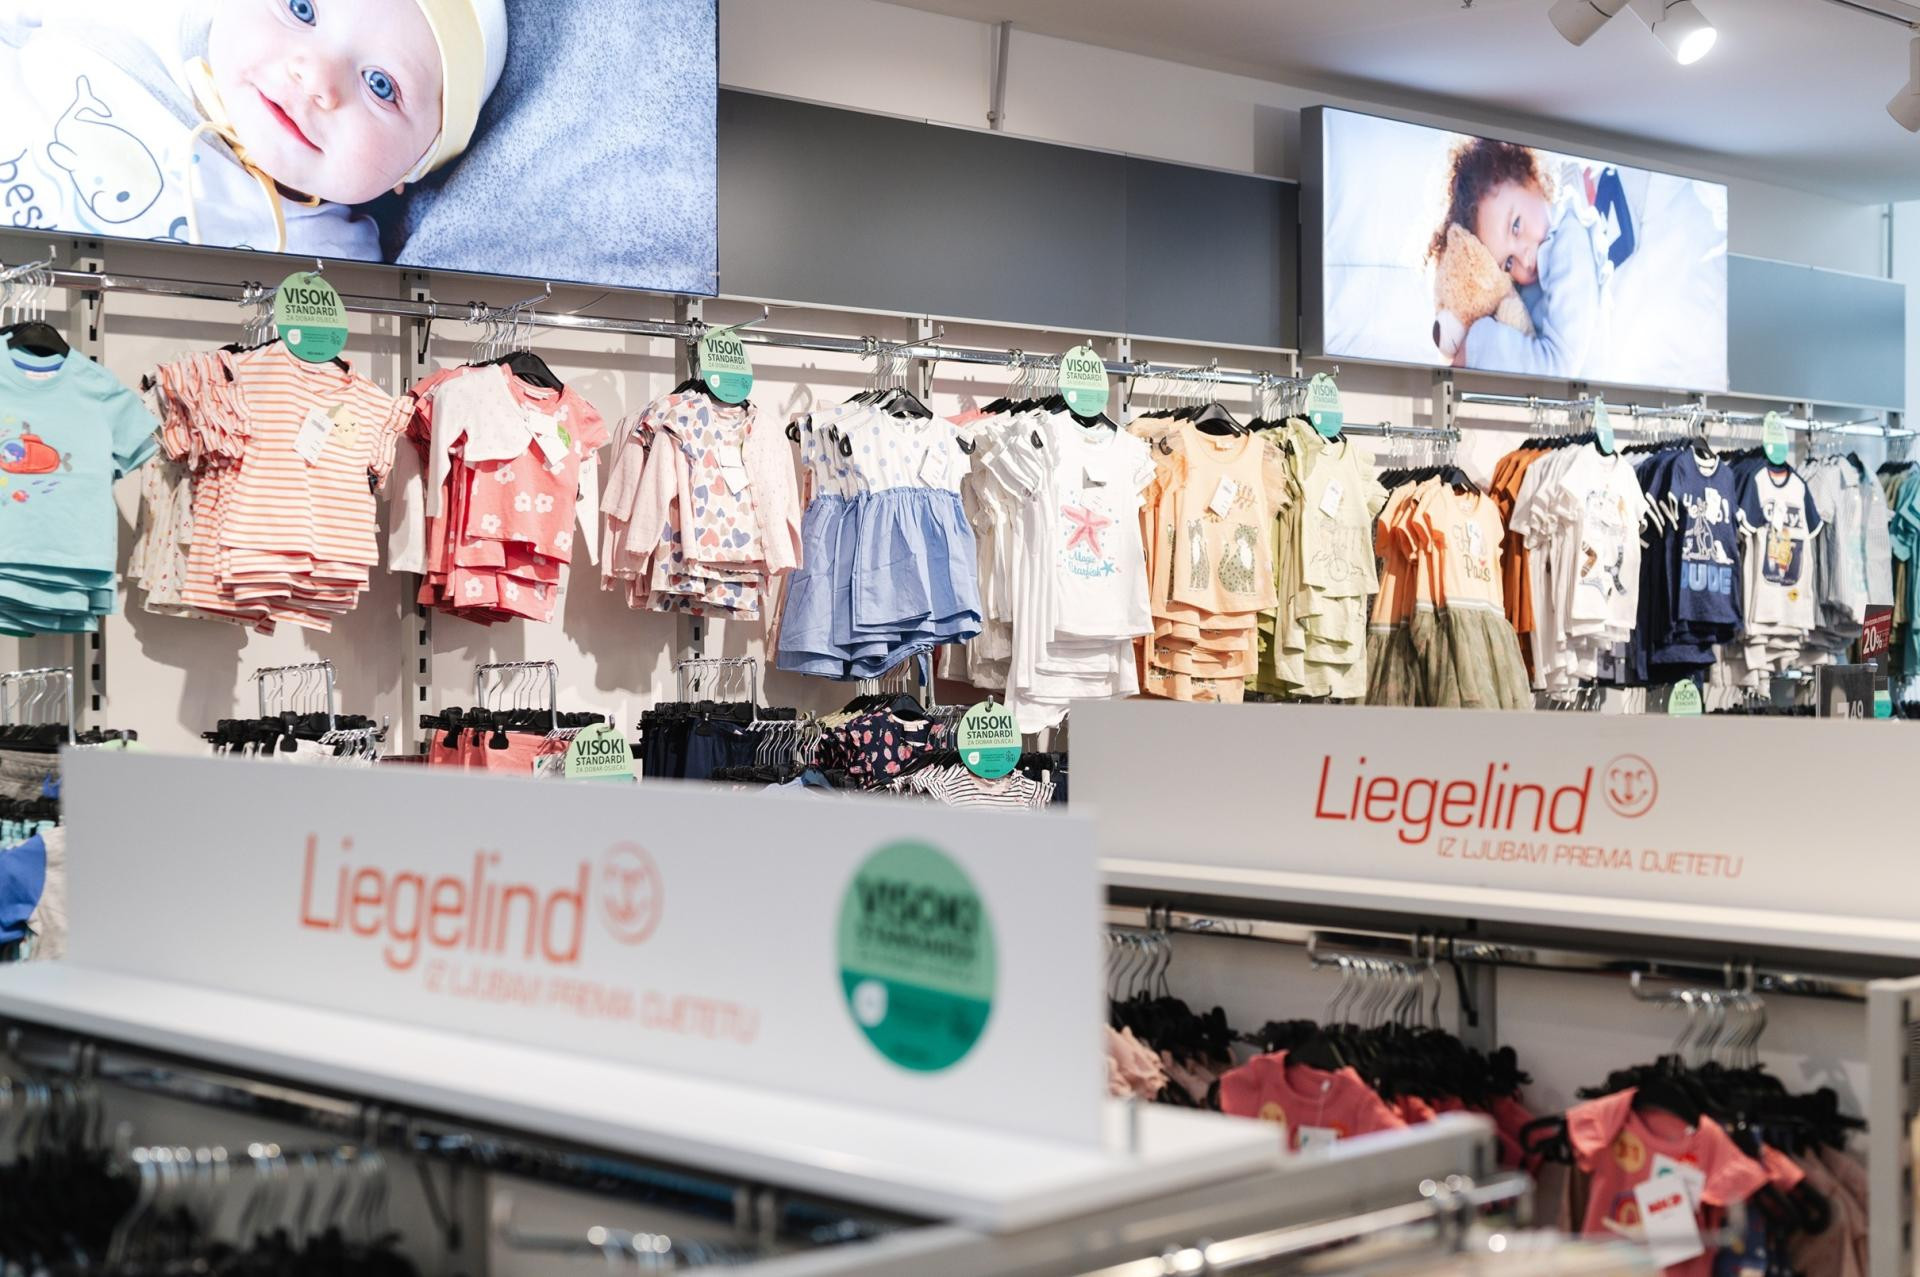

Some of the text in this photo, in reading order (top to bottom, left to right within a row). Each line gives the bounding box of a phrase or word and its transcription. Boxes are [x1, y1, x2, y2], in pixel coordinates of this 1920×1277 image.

[0, 148, 57, 231] bes
[283, 286, 337, 307] VISOKI
[285, 304, 338, 317] STANDARDI
[706, 338, 744, 356] VISOKI
[707, 353, 746, 365] STANDARDI
[1066, 358, 1101, 374] VISOKI
[1066, 371, 1102, 382] STANDARDI
[1863, 626, 1883, 655] 20%
[966, 716, 1013, 731] VISOKI
[966, 730, 1013, 740] STANDARDI
[576, 738, 625, 756] VISOKI
[576, 754, 625, 766] STANDARDI
[1314, 754, 1595, 845] Liegelind
[1437, 837, 1745, 879] IZ LJUBAVI PREMA DJETETU
[299, 833, 595, 970] Liegelind
[855, 874, 982, 937] VISOKI
